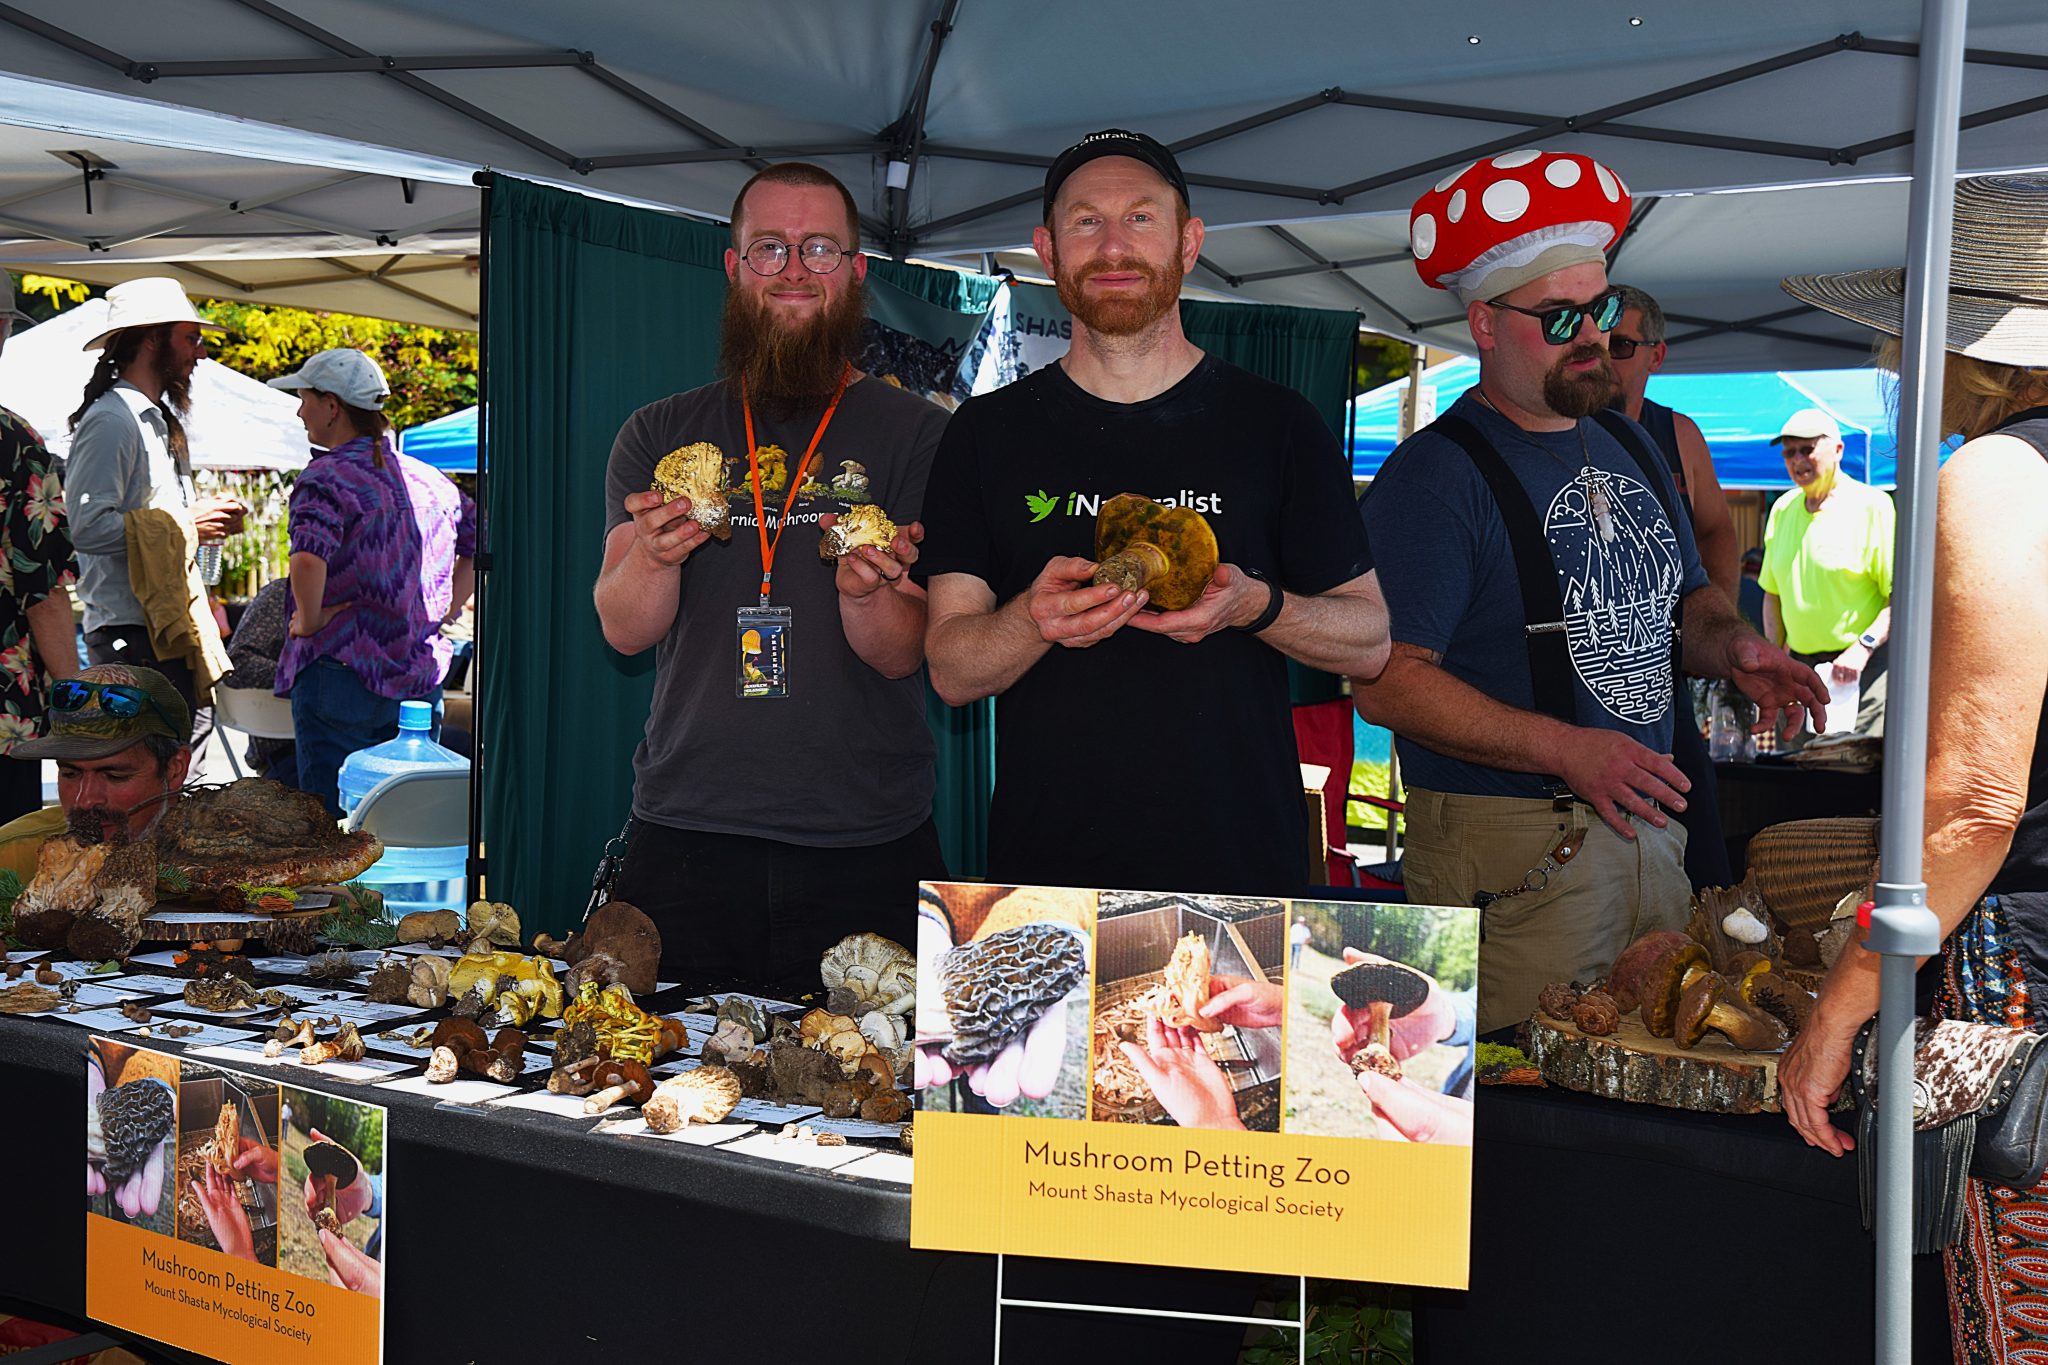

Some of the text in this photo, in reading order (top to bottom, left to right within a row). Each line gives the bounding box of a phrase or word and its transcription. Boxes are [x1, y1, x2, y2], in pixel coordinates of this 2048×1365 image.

[1066, 489, 1222, 514] iNalist
[771, 634, 779, 685] PRESENTER
[1025, 1140, 1350, 1188] Mushroom Petting Zoo
[1029, 1180, 1344, 1222] Mount Shasta Mycological Society
[142, 1247, 315, 1317] Mushroom Petting Zoo
[145, 1278, 312, 1345] Mount Shasta Mycological Society
